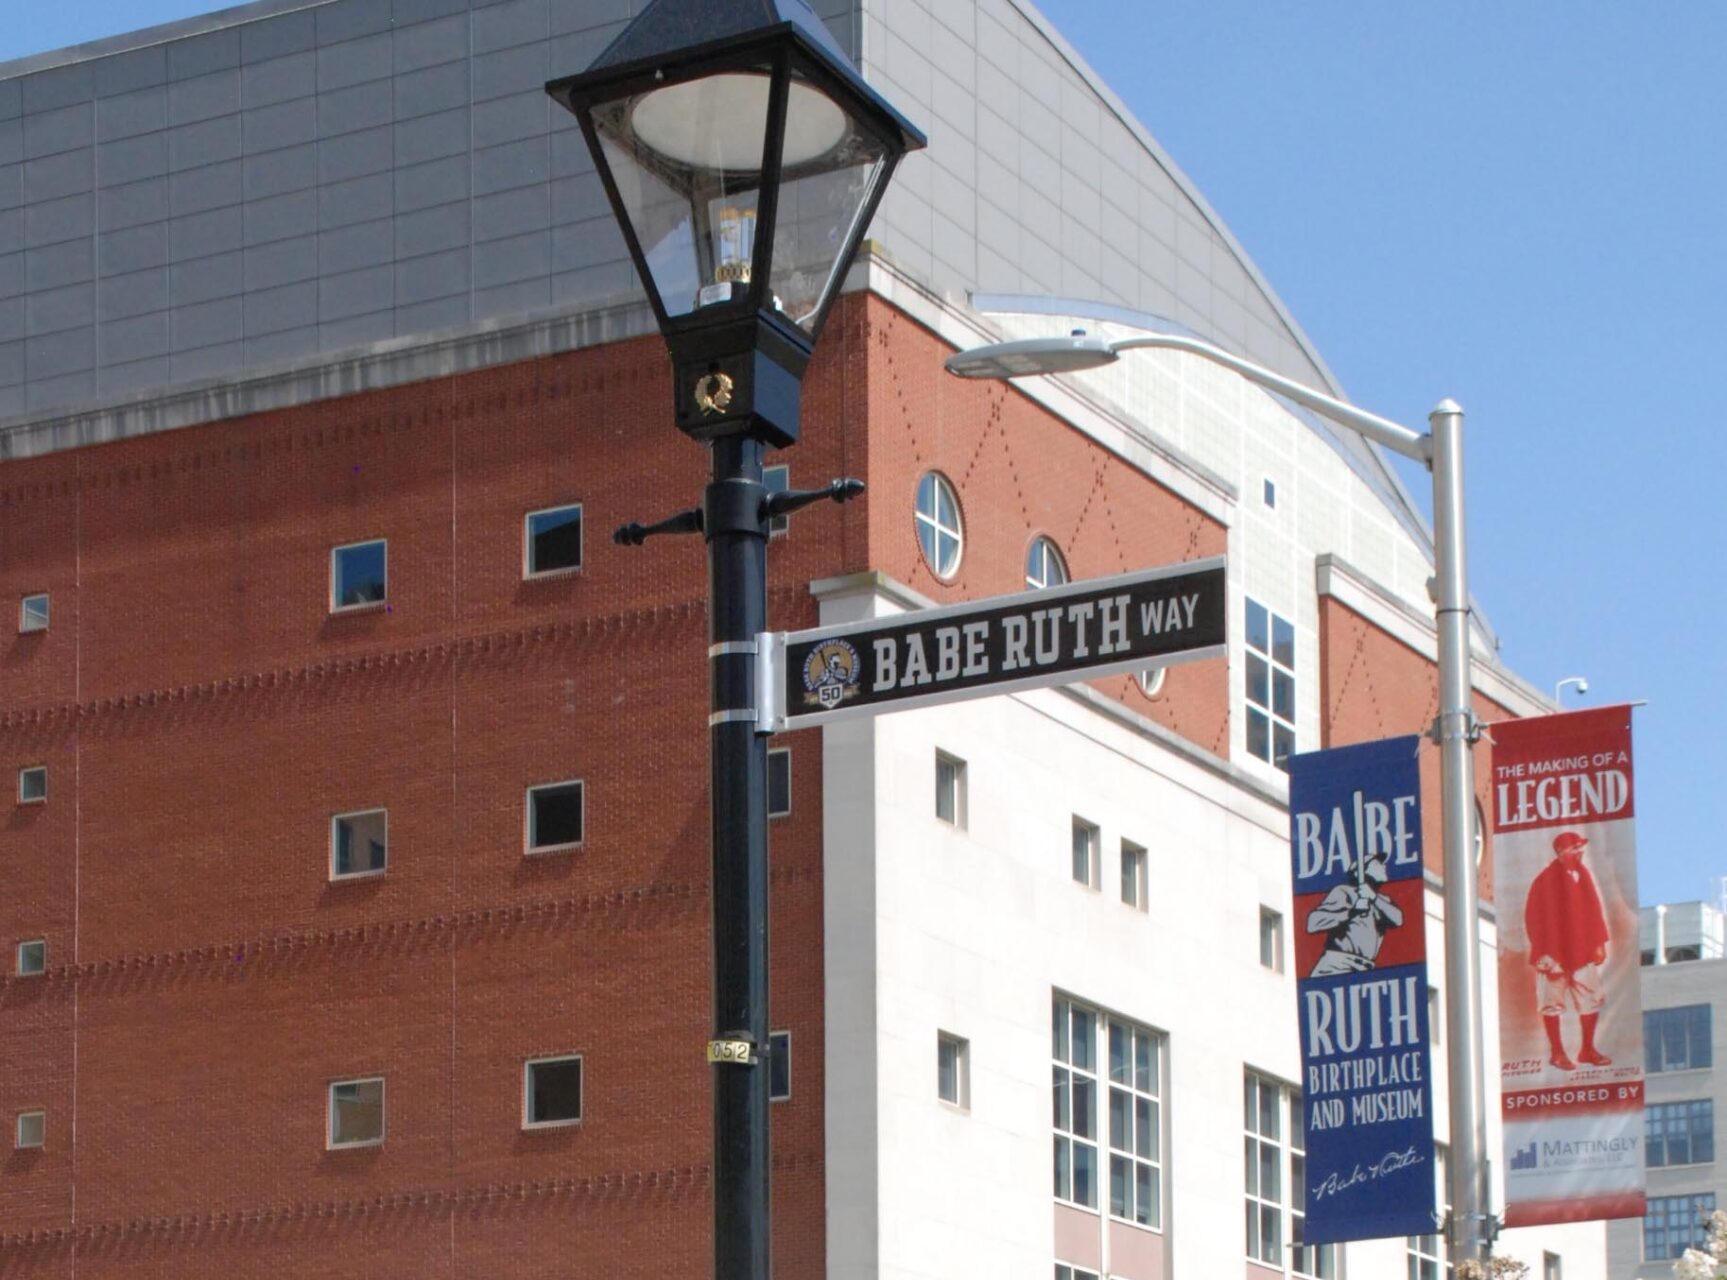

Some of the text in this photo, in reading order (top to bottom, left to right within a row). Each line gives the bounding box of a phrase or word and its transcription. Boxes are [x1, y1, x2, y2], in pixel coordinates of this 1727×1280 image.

[873, 594, 1199, 692] BABE RUTH WAY
[821, 686, 841, 701] 50
[1497, 751, 1628, 778] THE MAKING OF A
[1498, 769, 1629, 826] LEGEND
[1296, 795, 1419, 879] BABE
[1306, 976, 1420, 1058] RUTH
[1309, 1051, 1422, 1095] BIRTHPLACE
[1502, 1059, 1542, 1071] RUTH
[1310, 1088, 1423, 1131] AND MUSEUM
[1506, 1086, 1639, 1109] SPONSORED BY
